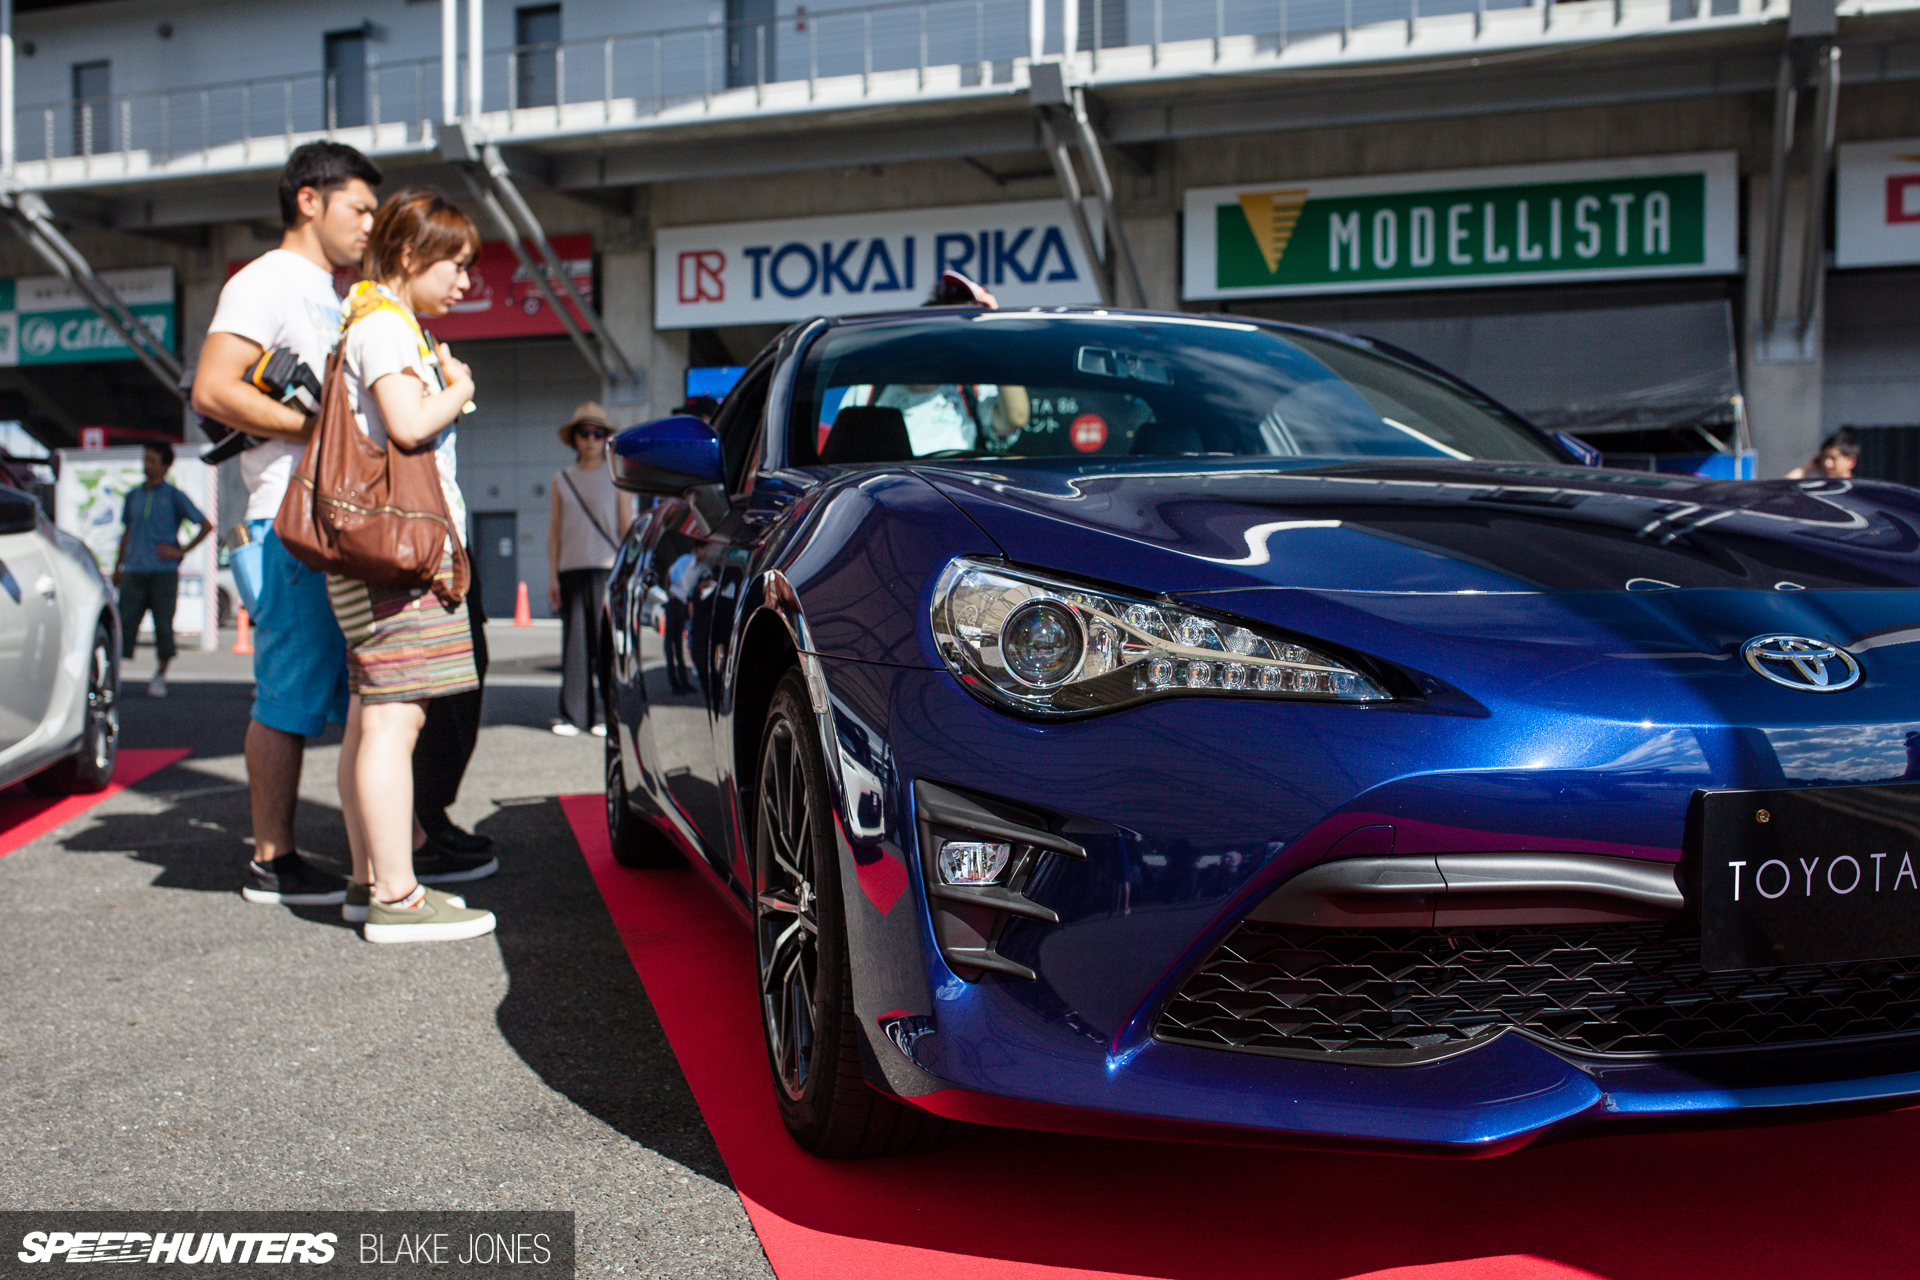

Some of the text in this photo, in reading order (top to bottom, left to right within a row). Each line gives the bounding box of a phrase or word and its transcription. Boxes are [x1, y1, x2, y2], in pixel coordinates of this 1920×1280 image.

[743, 235, 917, 300] TOKAI
[935, 225, 1079, 286] RIKA
[1329, 190, 1671, 272] MODELLISTA
[1728, 850, 1918, 901] TOYOTA
